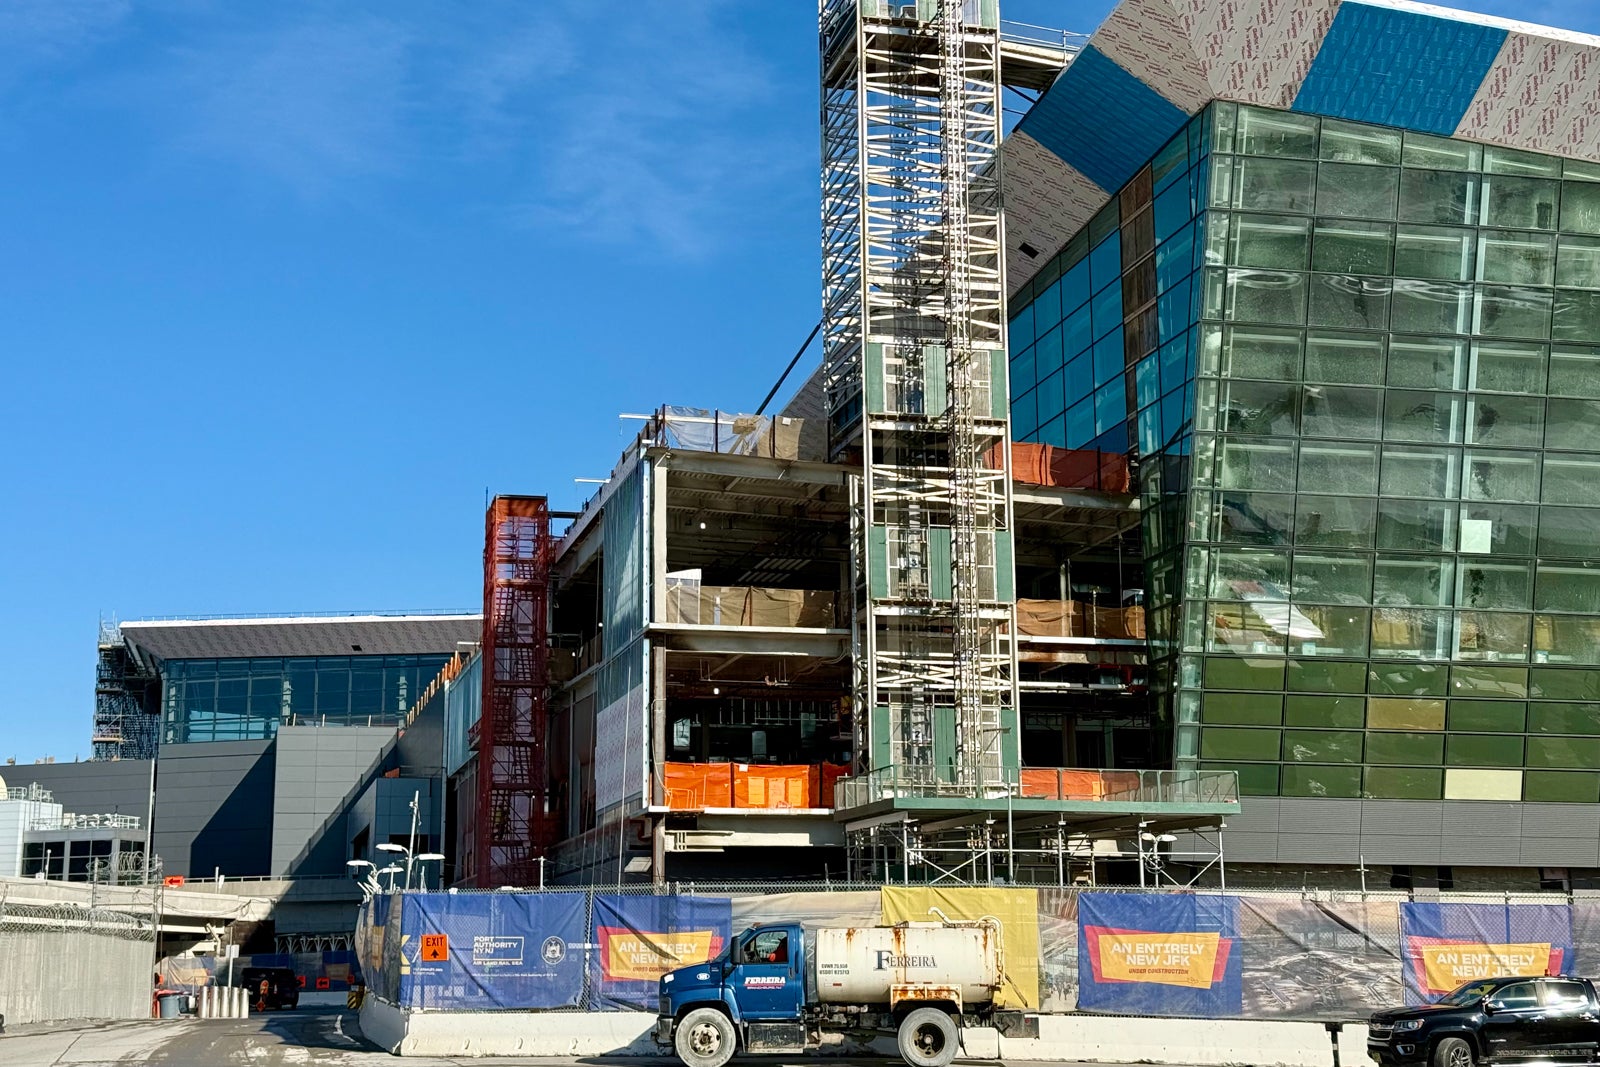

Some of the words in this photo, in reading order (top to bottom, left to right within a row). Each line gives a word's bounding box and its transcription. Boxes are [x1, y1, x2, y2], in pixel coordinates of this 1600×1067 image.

[426, 937, 444, 947] EXIT
[619, 942, 637, 953] AN
[1111, 943, 1132, 954] AN
[1135, 943, 1204, 955] ENTIRELY
[631, 954, 660, 964] NEW
[873, 950, 937, 971] FERREIRA
[1126, 954, 1160, 965] NEW
[1163, 955, 1190, 966] JFK
[1437, 953, 1458, 964] AN
[1452, 966, 1488, 976] NEW
[744, 976, 786, 984] FERREIRA
